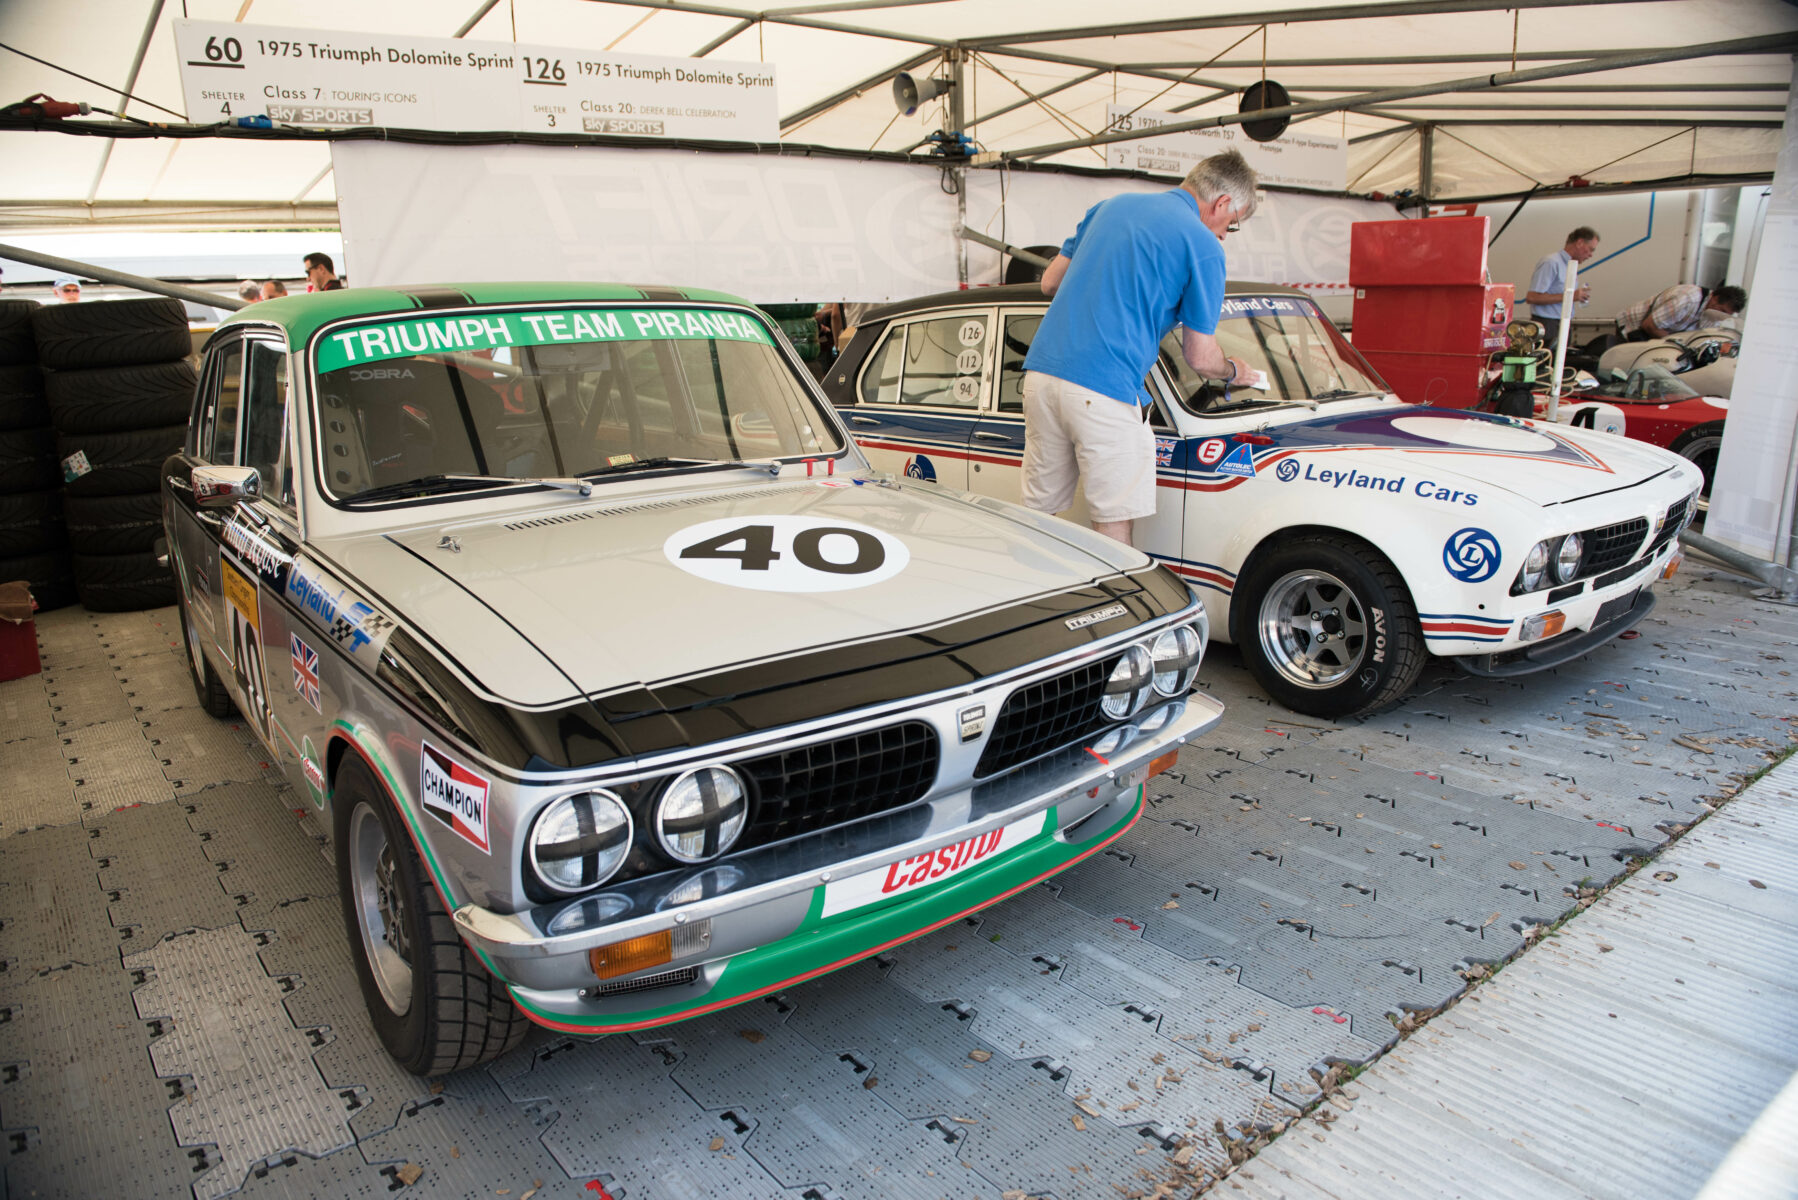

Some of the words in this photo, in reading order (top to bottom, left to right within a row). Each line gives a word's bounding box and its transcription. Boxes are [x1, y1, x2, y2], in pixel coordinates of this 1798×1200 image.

[204, 36, 244, 63] 60
[257, 40, 304, 58] 1975
[308, 43, 382, 65] Triumph
[388, 48, 462, 67] Dolomite
[468, 52, 515, 71] Sprint
[523, 56, 566, 81] 126
[576, 61, 611, 77] 1975
[615, 64, 671, 84] Triumph
[676, 68, 734, 85] Dolomite
[737, 73, 774, 90] Sprint
[201, 90, 246, 101] SHELTER
[263, 85, 307, 101] Class
[332, 90, 381, 103] TOURING
[384, 92, 418, 104] ICONS
[220, 102, 232, 117] 4
[269, 106, 298, 122] sky
[302, 107, 371, 124] SPORTS
[533, 105, 567, 114] SHELTER
[580, 100, 614, 113] Class
[618, 102, 637, 115] 20:
[685, 108, 737, 119] CELEBRATION
[547, 114, 556, 128] 3
[610, 120, 663, 134] SPORTS
[1111, 113, 1133, 131] 125
[1222, 129, 1235, 141] TS7
[1119, 154, 1125, 164] 2
[1137, 145, 1155, 156] Class
[1262, 297, 1294, 311] Cars
[332, 316, 514, 361] TRIUMPH
[521, 312, 625, 342] TEAM
[636, 311, 762, 340] PIRANHA
[963, 328, 978, 340] 126
[961, 356, 976, 368] 112
[349, 368, 416, 381] COBRA
[960, 383, 971, 395] 94
[1203, 442, 1220, 459] E
[1305, 463, 1405, 494] Leyland
[1415, 481, 1479, 506] Cars
[678, 525, 886, 576] 40
[289, 562, 345, 625] Leyland
[1068, 605, 1126, 628] TRIUMPH
[1371, 606, 1387, 663] AVON
[424, 768, 482, 825] CHAMPION
